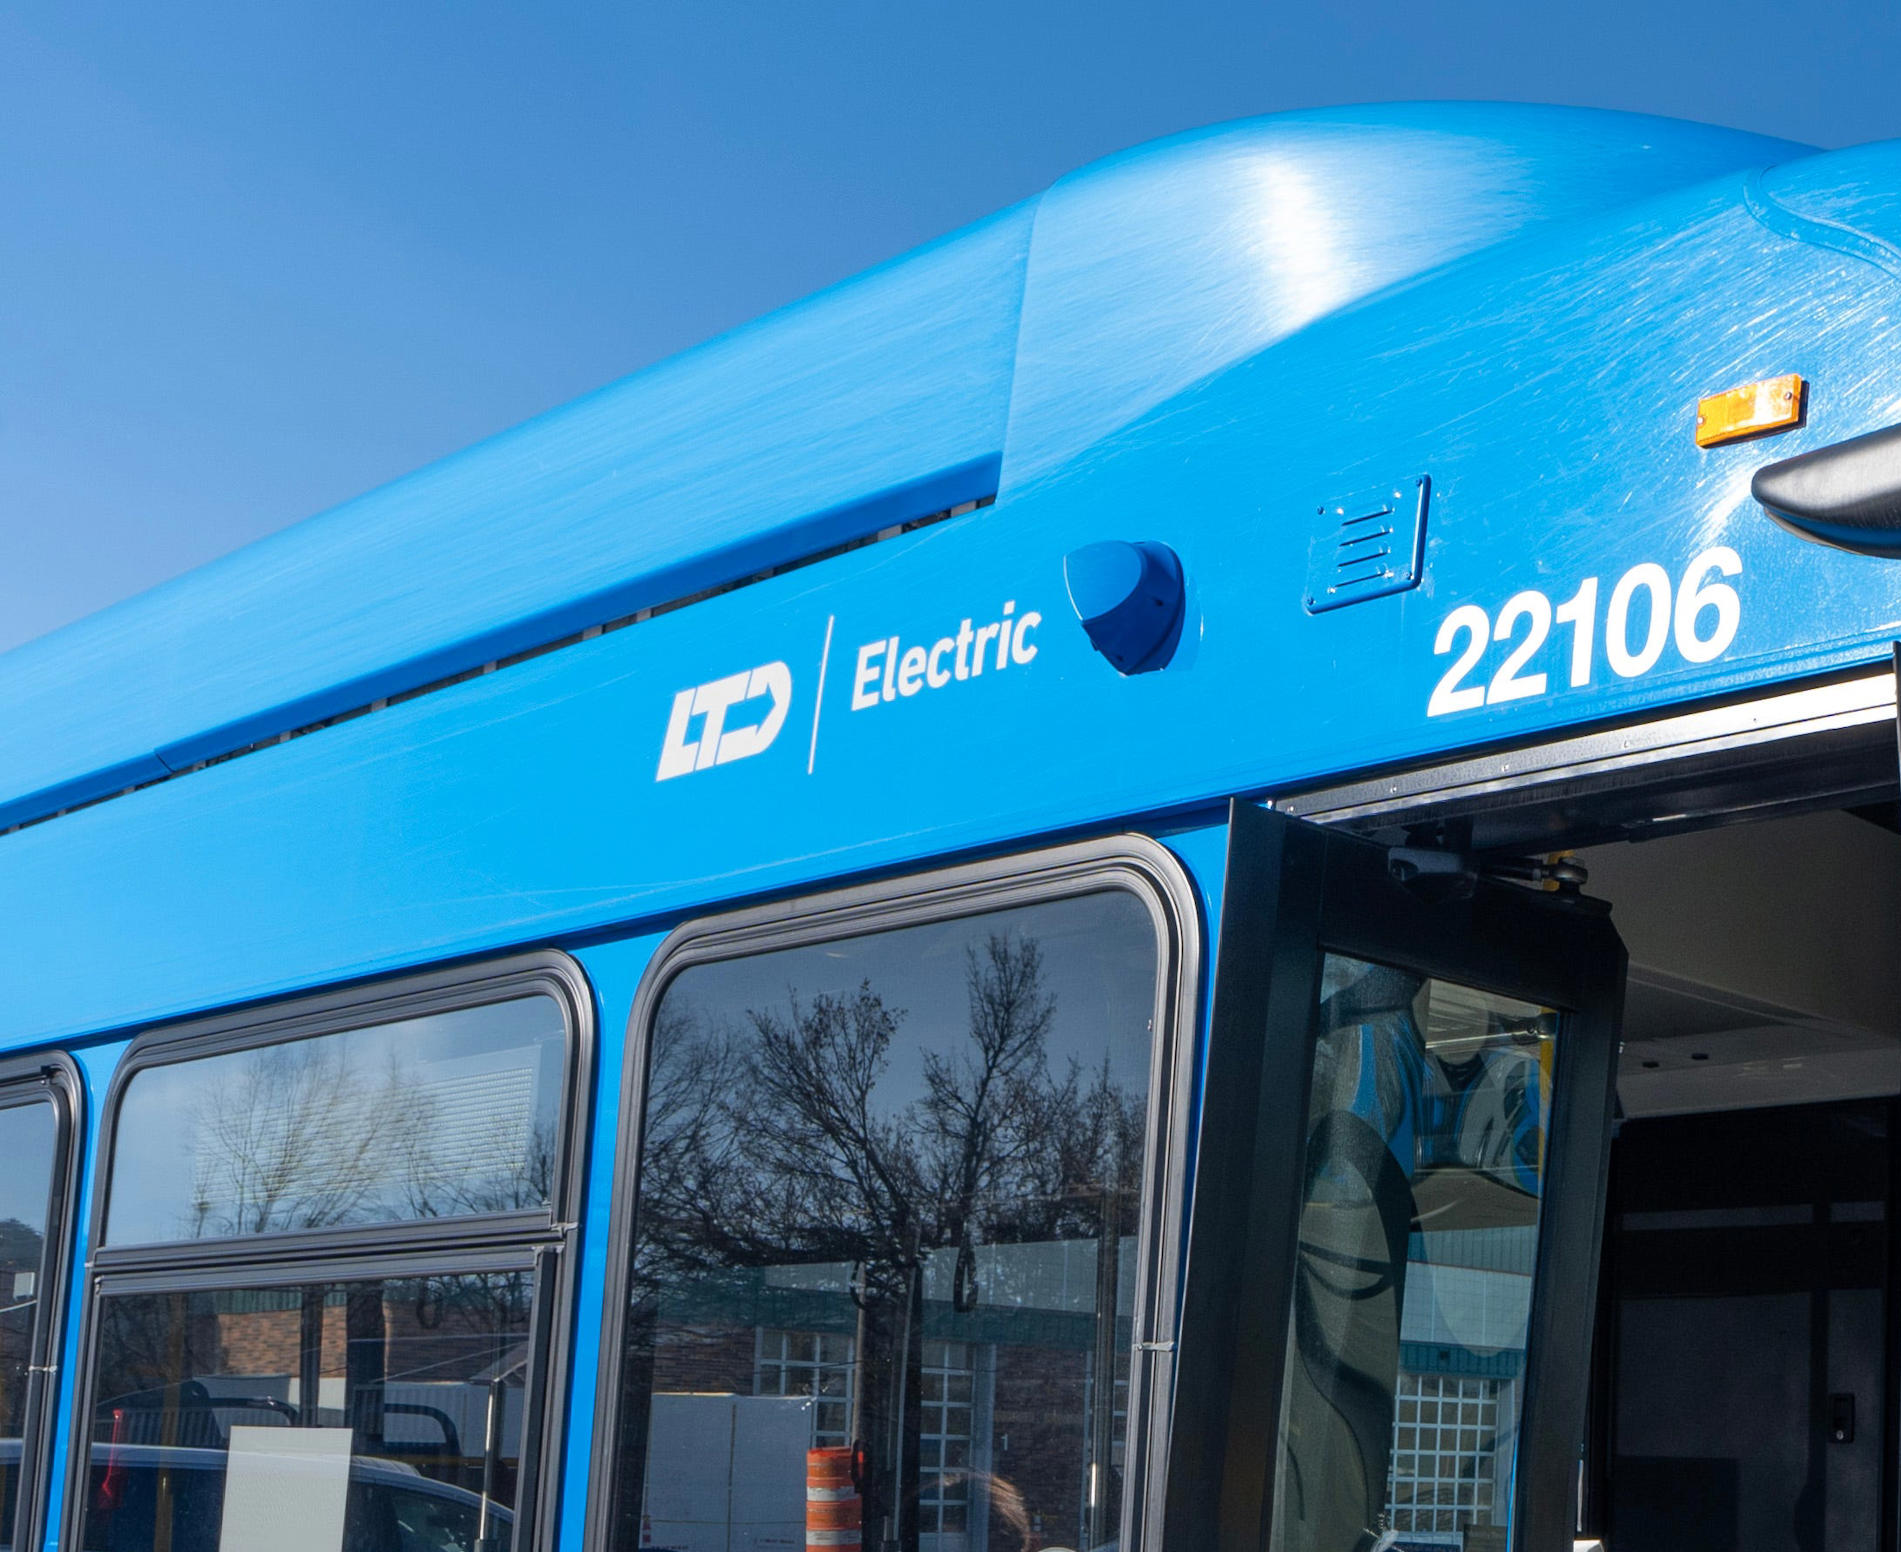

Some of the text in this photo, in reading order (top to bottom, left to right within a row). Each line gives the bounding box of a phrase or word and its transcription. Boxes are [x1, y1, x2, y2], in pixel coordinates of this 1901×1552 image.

[655, 600, 1041, 783] LTD Electric
[1427, 546, 1743, 717] 22106
